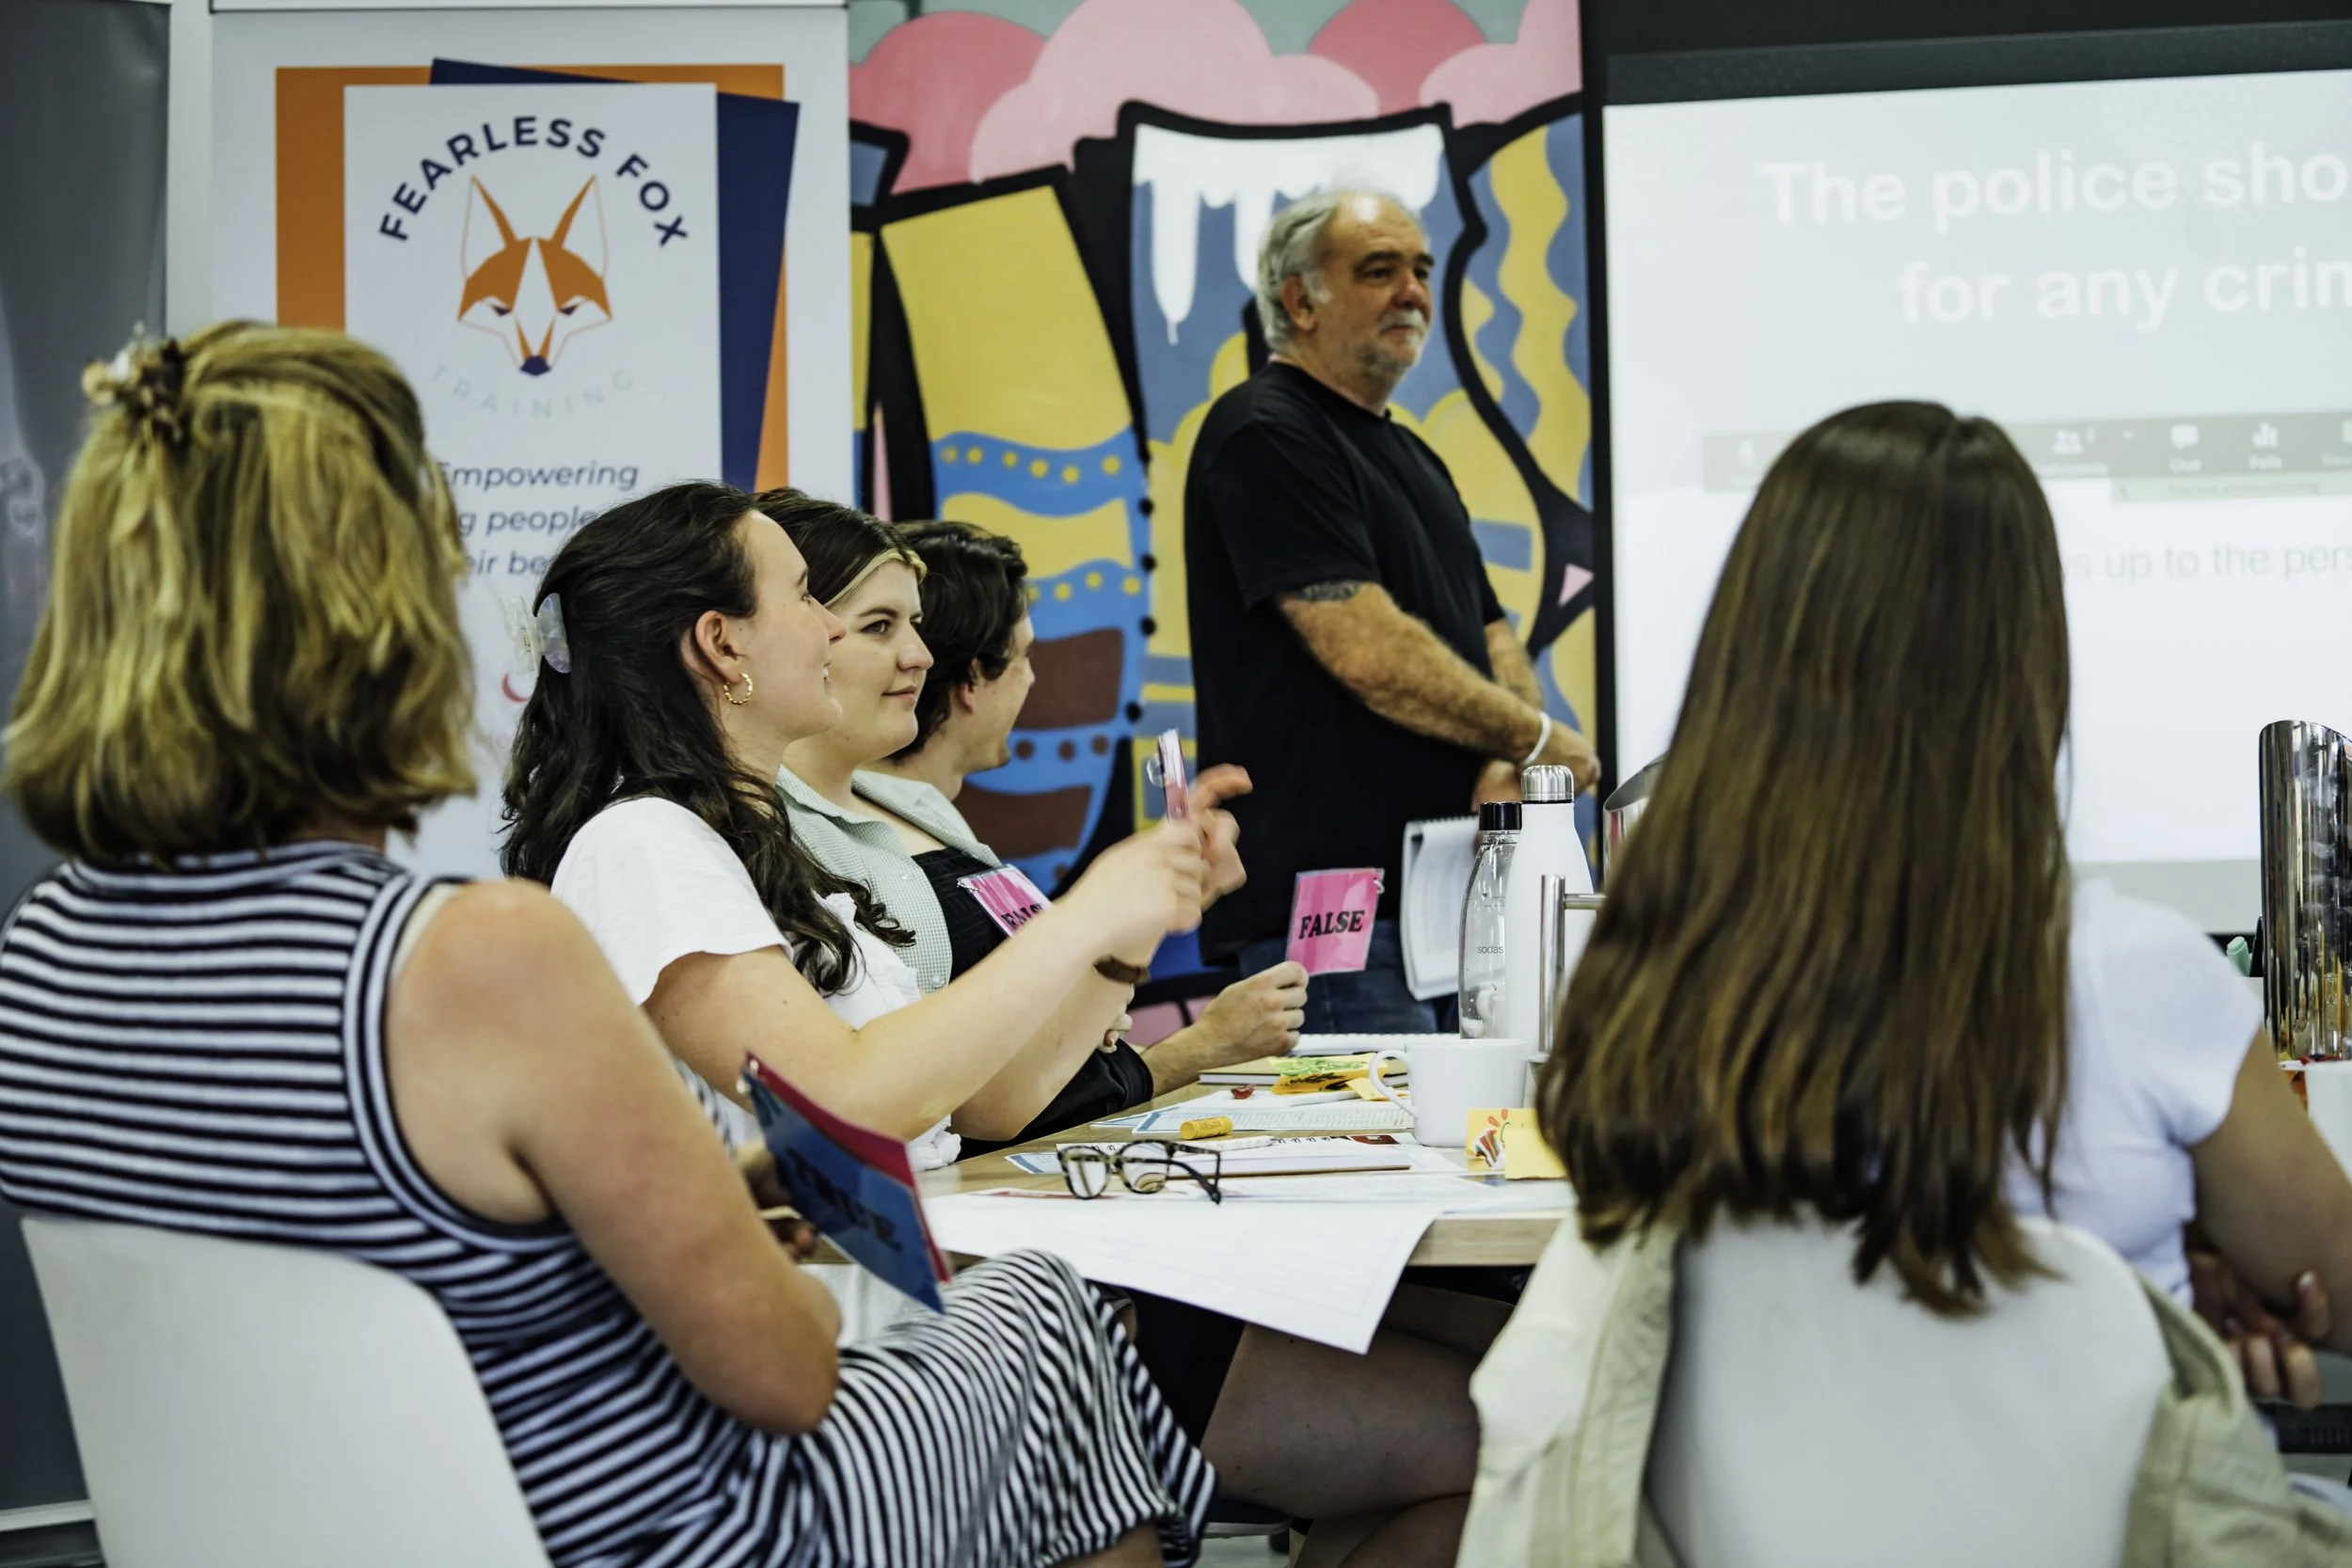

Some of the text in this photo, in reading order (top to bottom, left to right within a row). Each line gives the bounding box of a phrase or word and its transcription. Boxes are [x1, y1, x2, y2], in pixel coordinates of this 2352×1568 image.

[379, 115, 690, 247] FEARLESS FOX
[1756, 140, 2350, 237] The police sho
[1898, 260, 2014, 325] for
[2035, 266, 2180, 333] any
[428, 361, 636, 420] TRAINING
[2104, 548, 2153, 587] up
[2164, 543, 2201, 578] to
[2212, 540, 2271, 578] the
[1298, 910, 1365, 940] FALSE
